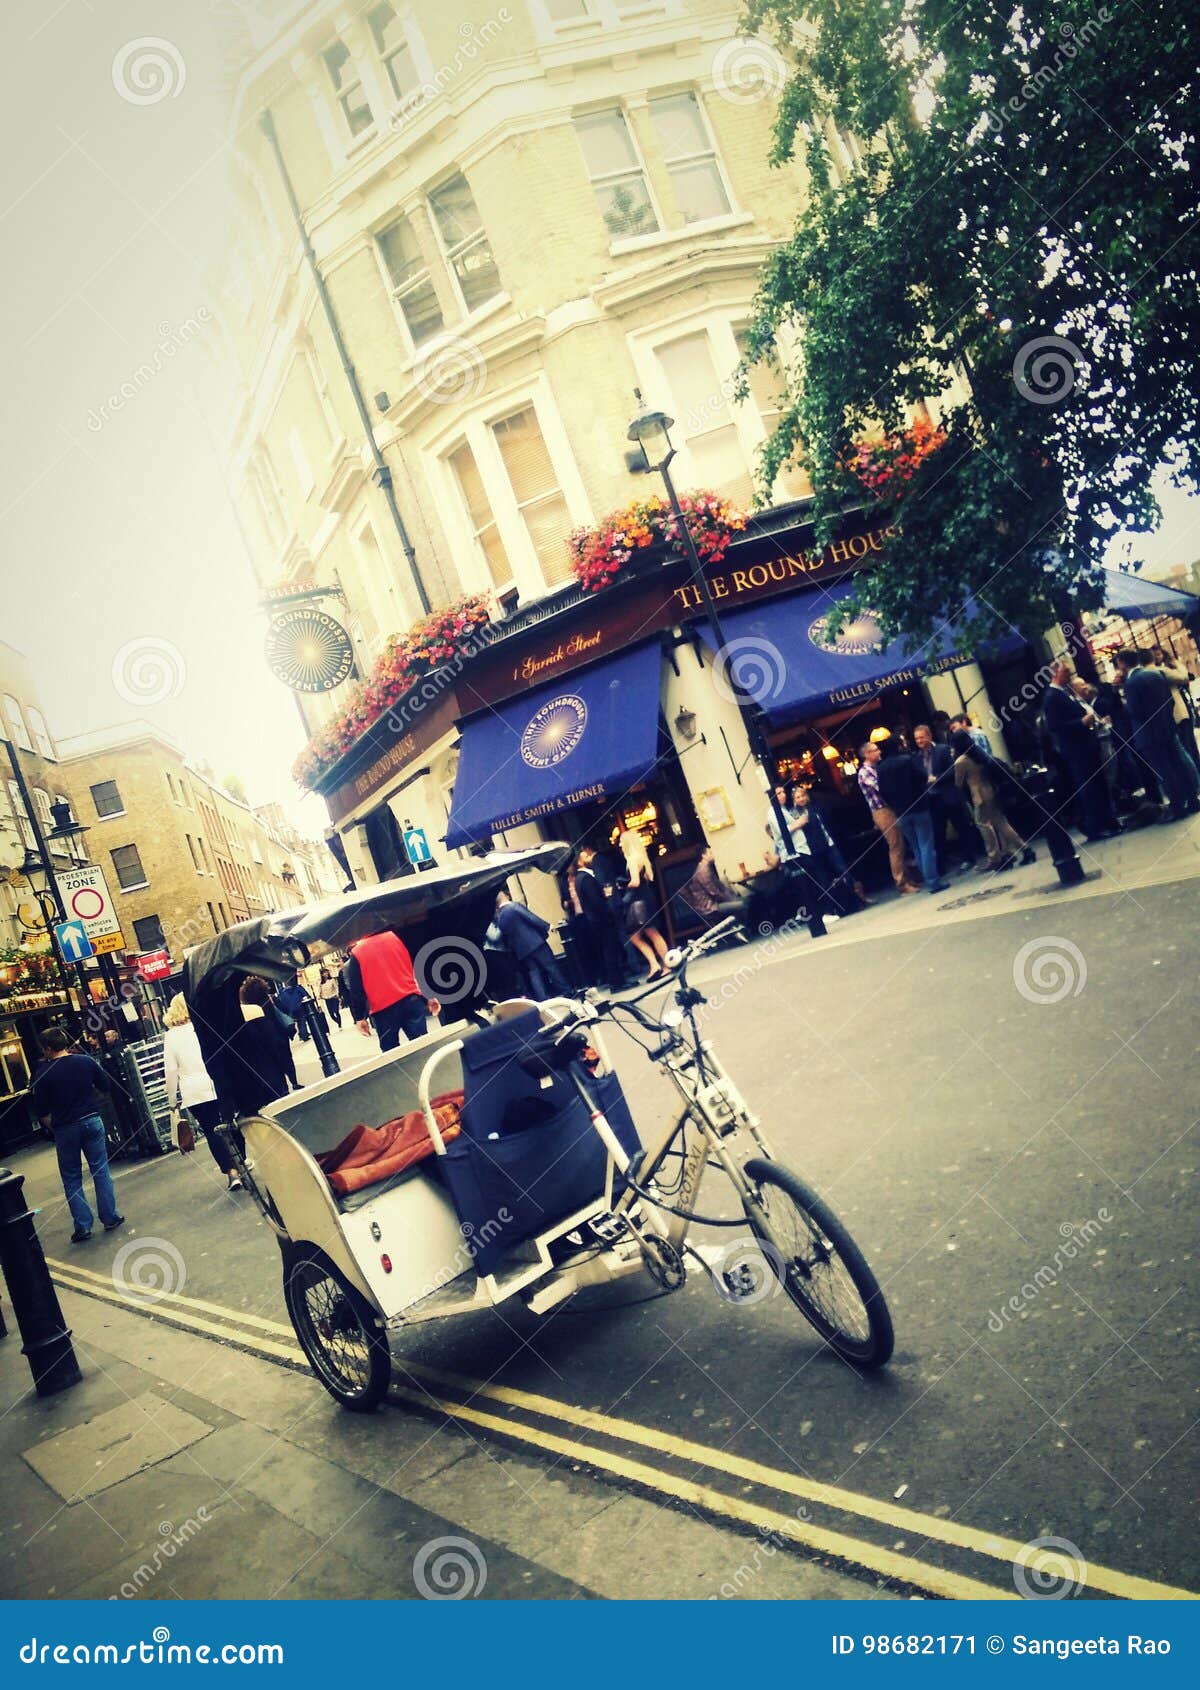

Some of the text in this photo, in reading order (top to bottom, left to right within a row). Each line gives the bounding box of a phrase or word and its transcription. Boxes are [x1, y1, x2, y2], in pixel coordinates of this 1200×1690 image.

[674, 525, 904, 609] THE ROUND HOU
[272, 649, 352, 692] COVENT GARDEN
[522, 645, 565, 679] Garrick
[566, 629, 601, 655] Street
[829, 683, 872, 704] FULLER
[874, 671, 913, 689] SMITH
[524, 698, 585, 740] THE ROUNDHOUSE
[523, 725, 585, 766] COVENT GARDEN
[490, 783, 606, 832] FULLER SMITH & TURNER
[57, 869, 100, 881] PEDESTRIAN
[66, 877, 97, 890] ZONE
